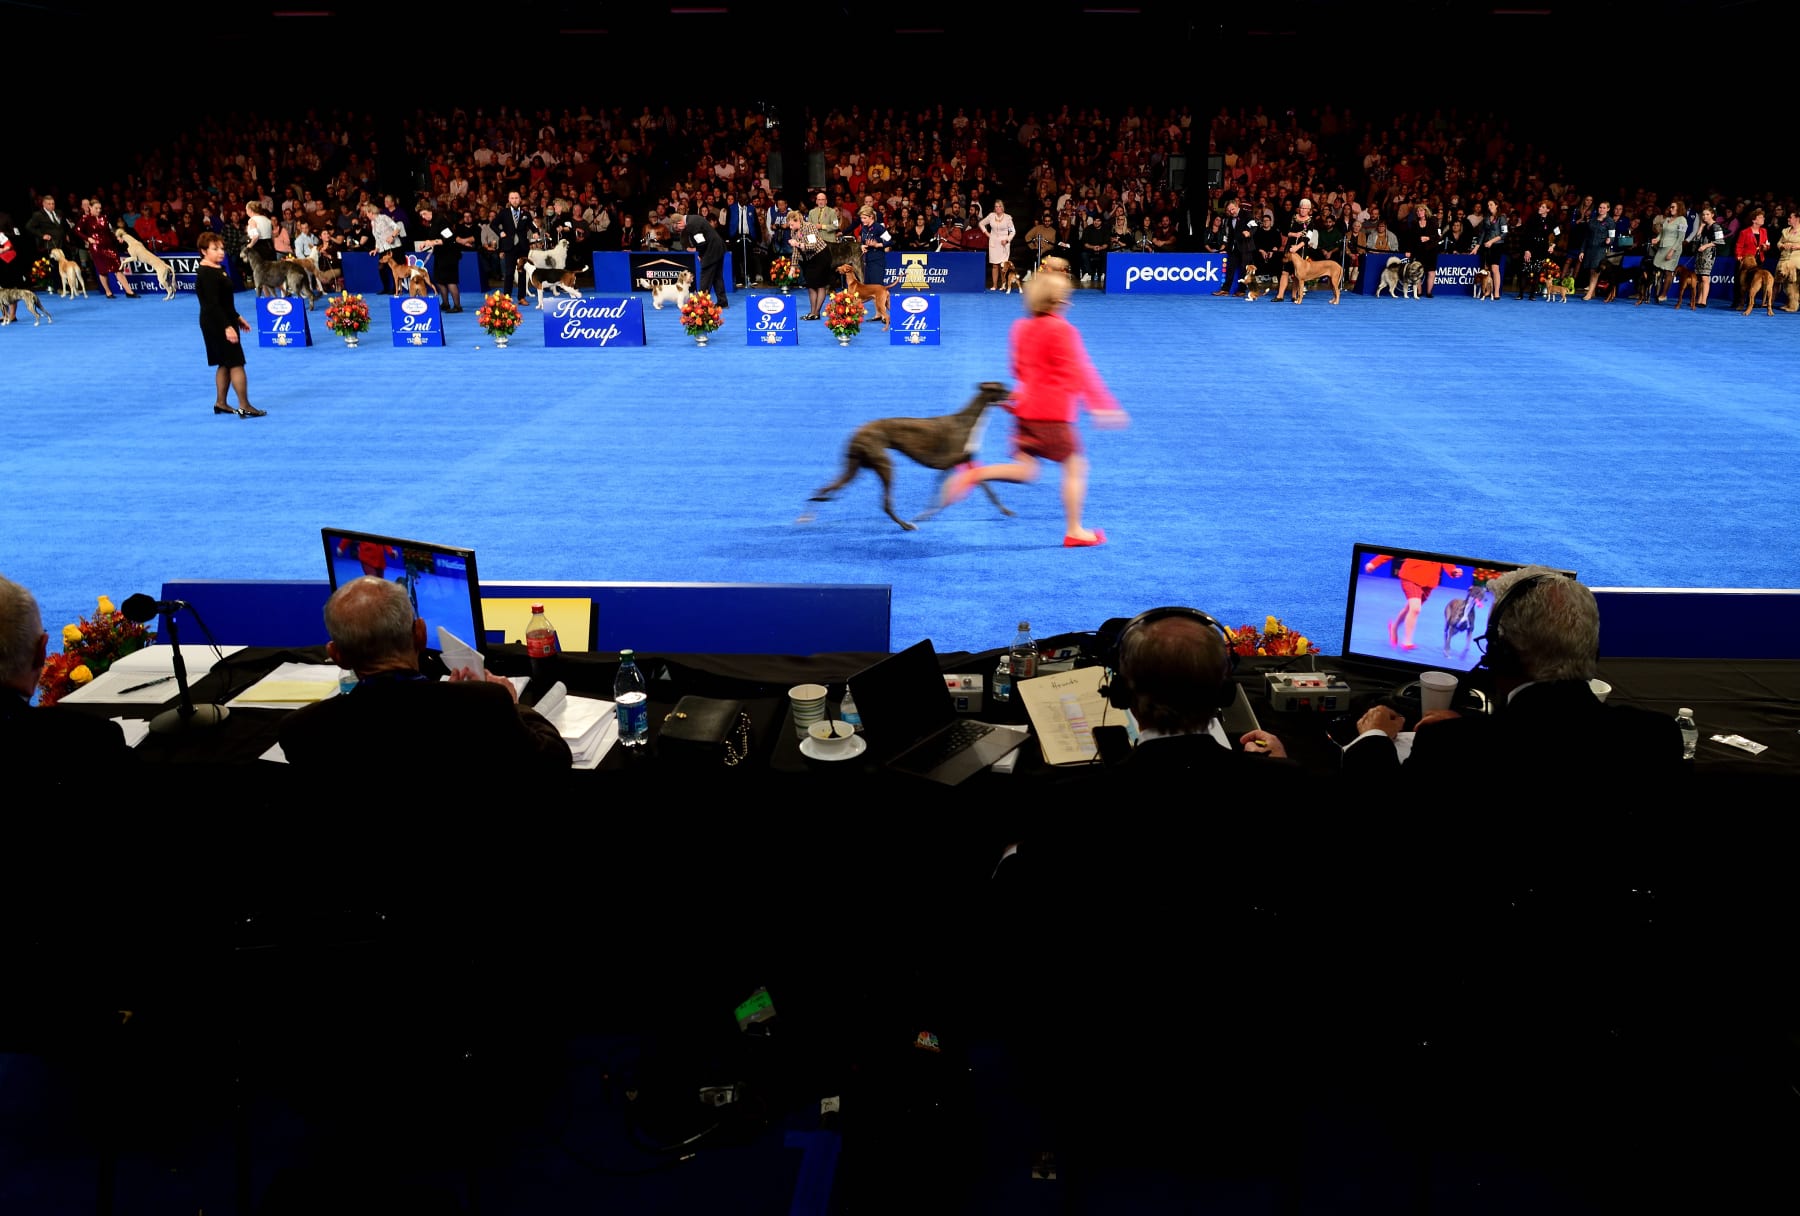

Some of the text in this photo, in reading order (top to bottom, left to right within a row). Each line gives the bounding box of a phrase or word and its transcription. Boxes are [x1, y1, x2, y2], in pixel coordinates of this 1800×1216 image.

[133, 259, 200, 273] PUINA
[929, 268, 949, 276] CLUB
[1125, 261, 1219, 290] peacock
[1433, 275, 1475, 285] ENNEL CLU
[140, 281, 158, 291] Pet,
[553, 299, 627, 318] Hound
[271, 315, 291, 332] 1st
[399, 315, 432, 331] 2nd
[755, 314, 787, 330] 3rd
[901, 313, 928, 330] 4th
[561, 319, 622, 346] Group
